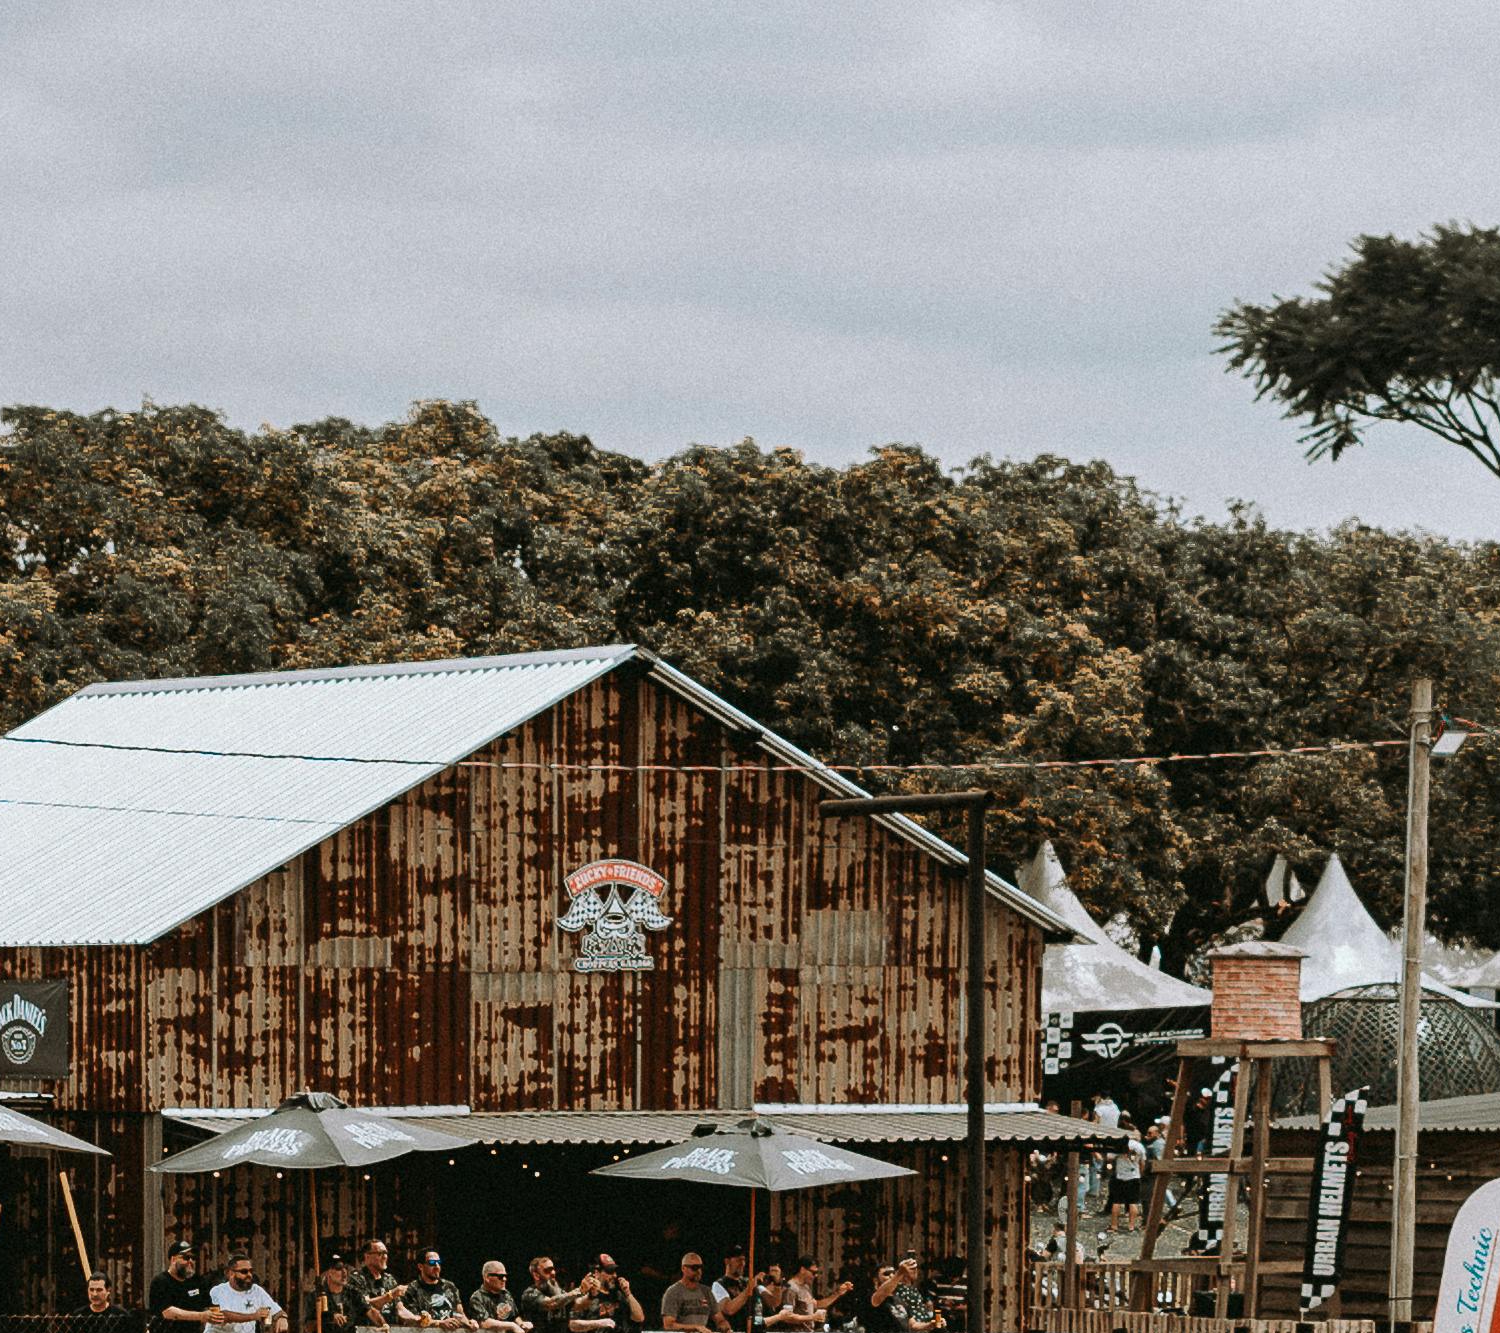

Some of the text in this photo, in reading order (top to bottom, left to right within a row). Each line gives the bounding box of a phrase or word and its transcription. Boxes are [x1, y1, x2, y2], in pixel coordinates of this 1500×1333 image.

[1313, 1141, 1350, 1276] URBAN HELMETS
[1457, 1226, 1493, 1315] Technic
